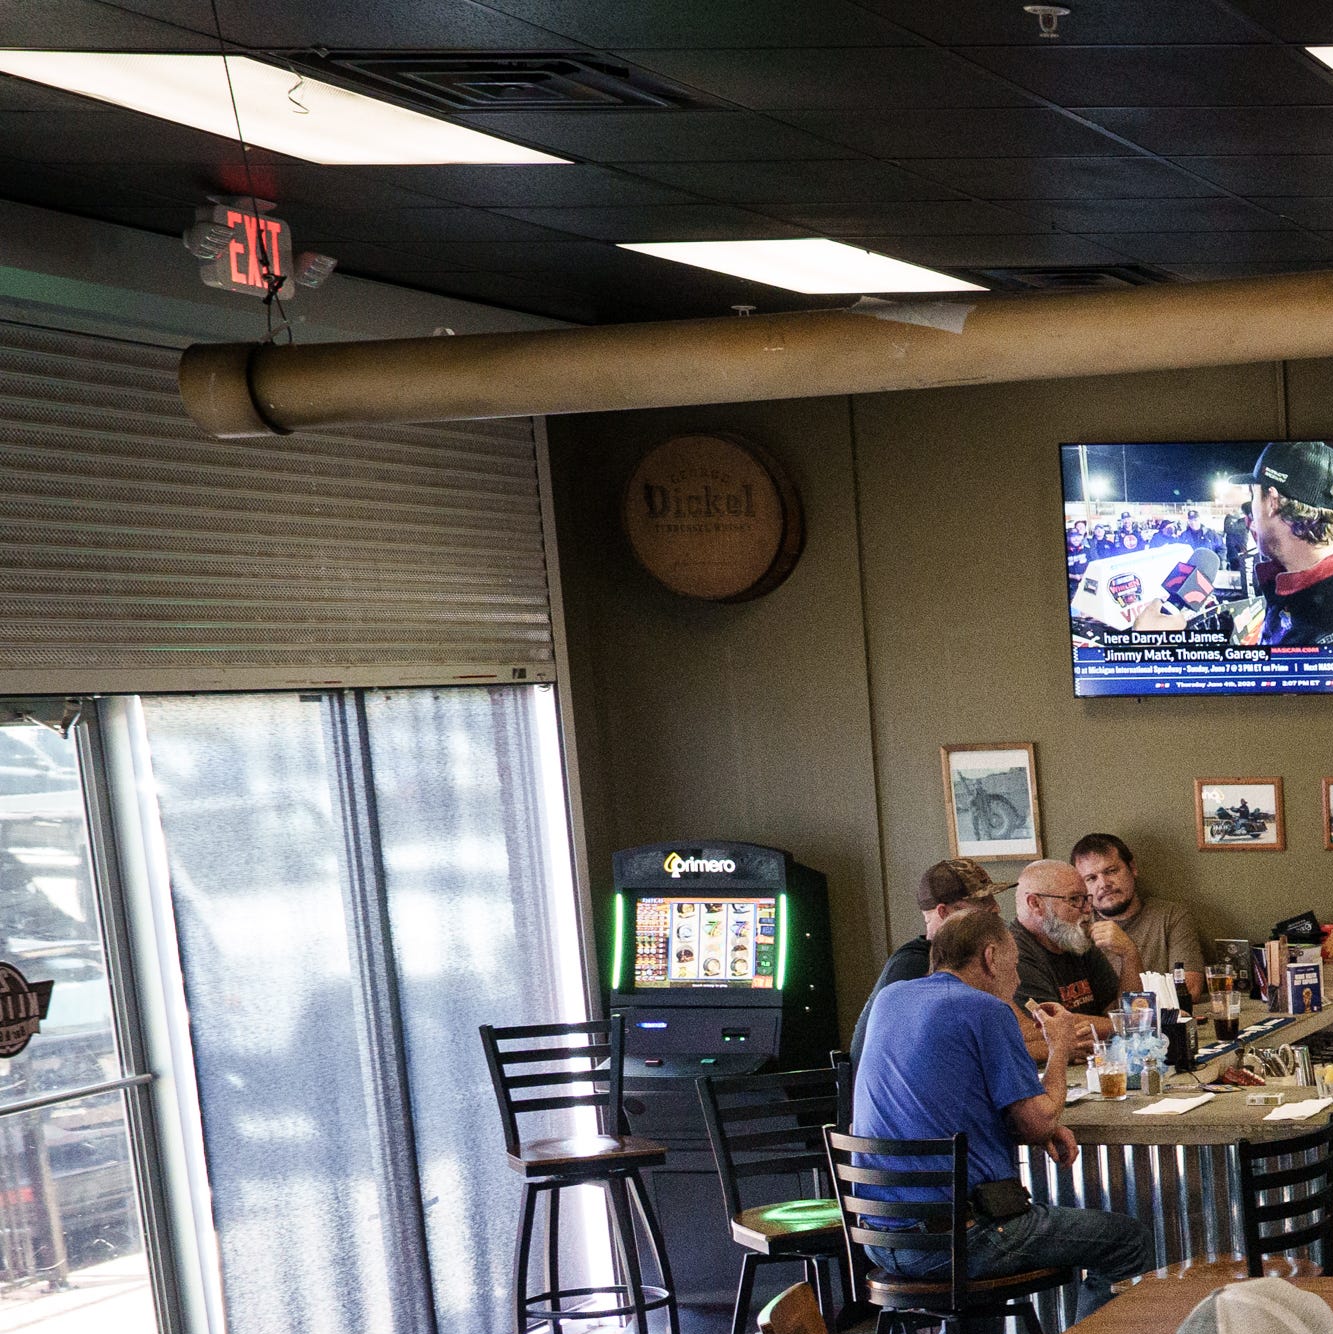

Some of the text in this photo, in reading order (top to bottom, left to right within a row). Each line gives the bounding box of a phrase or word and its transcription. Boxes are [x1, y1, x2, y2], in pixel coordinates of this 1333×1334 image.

[226, 209, 282, 293] EXIT
[643, 483, 757, 519] Dickel
[1104, 631, 1228, 647] here Darryl col James.
[1104, 648, 1269, 664] Jimmy Matt, Thomas, Garage,
[674, 855, 737, 878] primero
